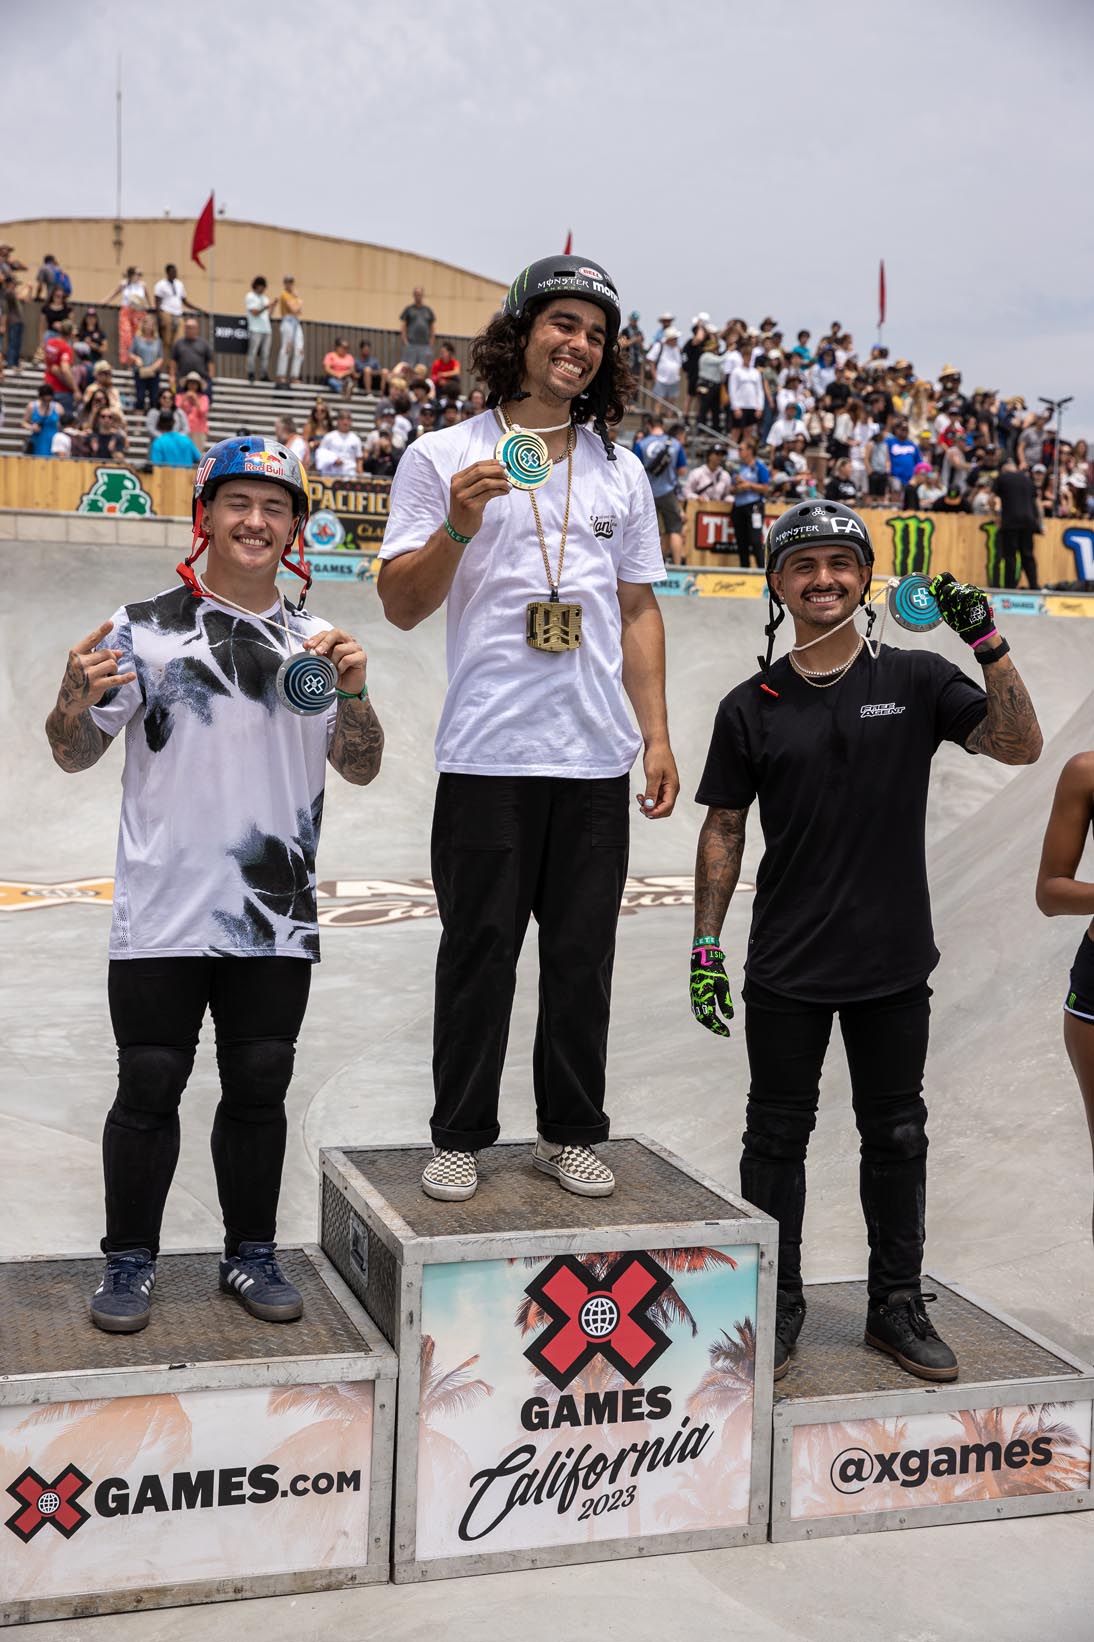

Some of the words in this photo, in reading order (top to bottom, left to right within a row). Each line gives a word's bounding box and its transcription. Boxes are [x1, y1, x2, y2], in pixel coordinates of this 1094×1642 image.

[537, 277, 590, 289] MONSTER
[582, 268, 601, 278] BELL
[245, 463, 265, 472] Red
[266, 465, 285, 477] Bull
[309, 482, 391, 514] PACIFIC
[775, 525, 820, 543] MONSTER
[830, 516, 865, 539] FA
[313, 563, 353, 574] GAMES
[520, 1385, 673, 1432] GAMES
[829, 1436, 1053, 1495] @xgames
[458, 1415, 714, 1542] California
[577, 1485, 638, 1521] 2023
